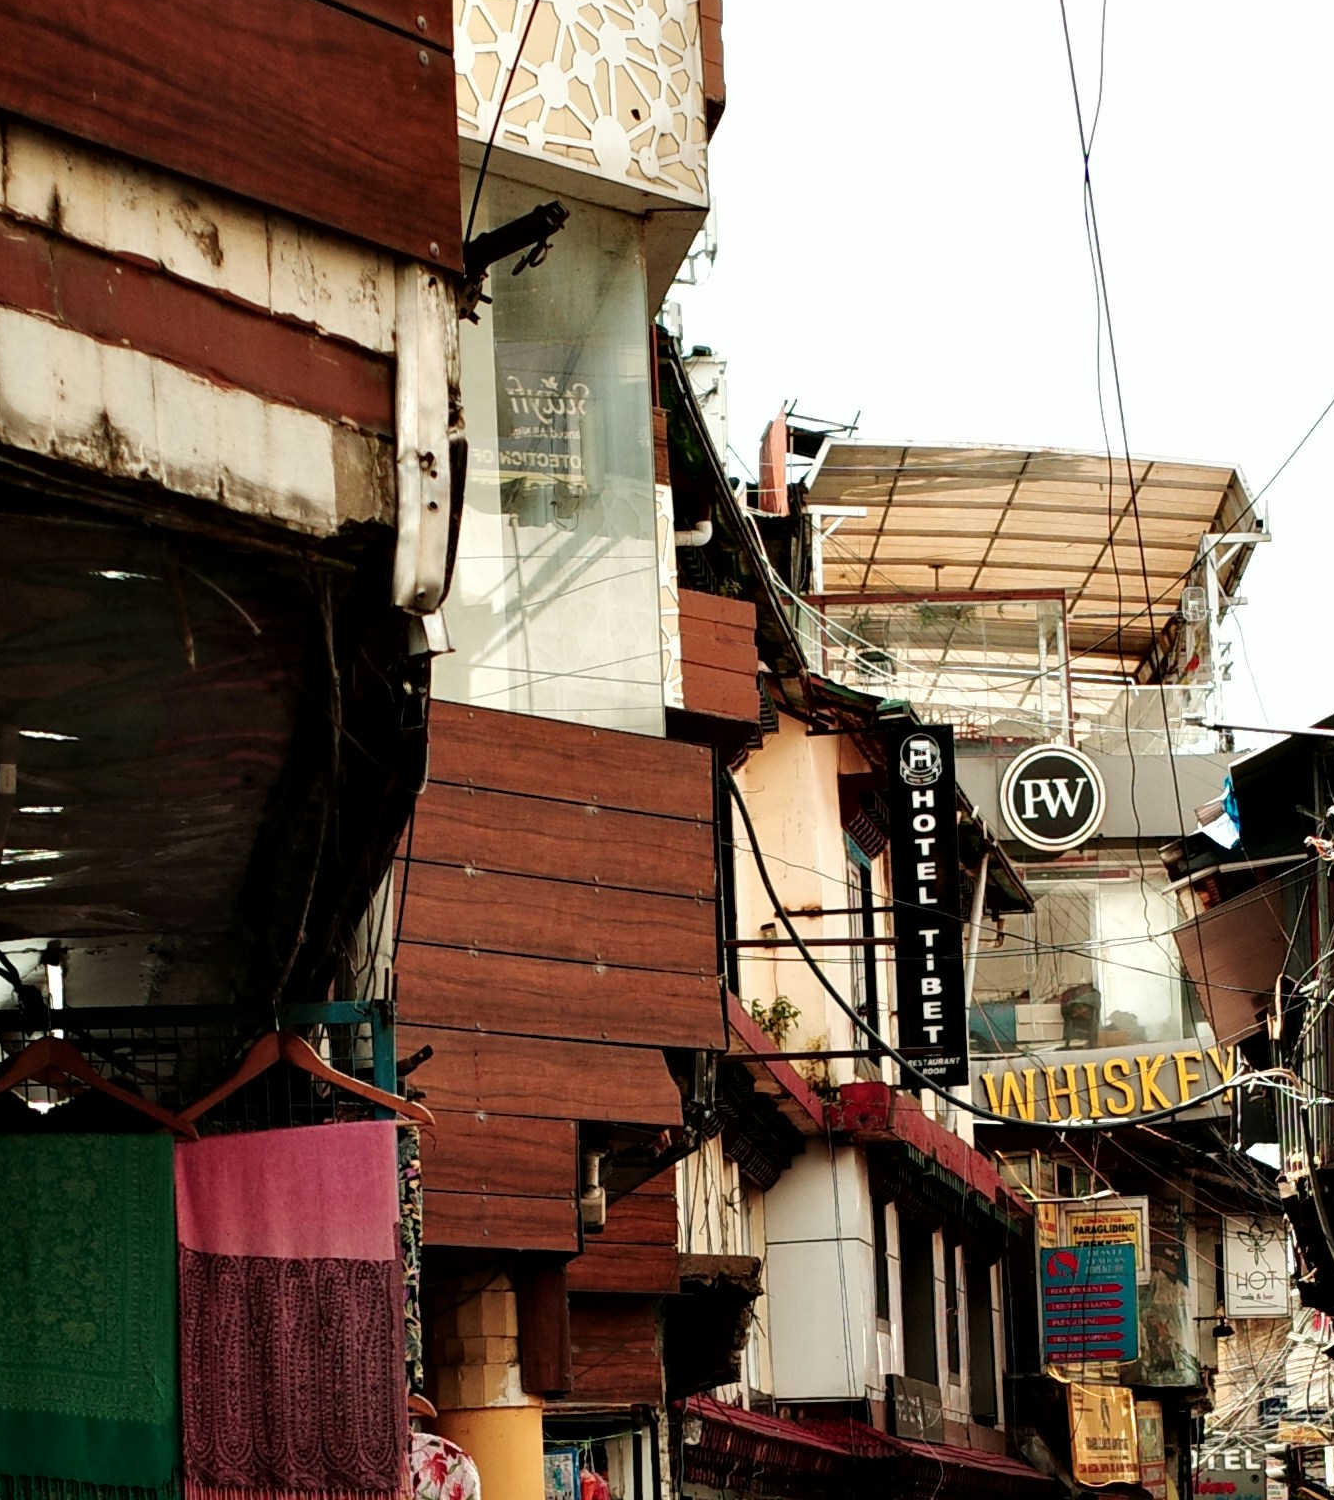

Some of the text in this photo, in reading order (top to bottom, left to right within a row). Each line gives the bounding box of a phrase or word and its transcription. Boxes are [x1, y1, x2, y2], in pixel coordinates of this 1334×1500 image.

[1019, 778, 1088, 819] PW
[912, 790, 938, 904] HOTEL
[907, 1057, 961, 1067] RESTAURANT
[981, 1045, 1234, 1122] WHISKEY
[1073, 1223, 1135, 1236] PARAGLIDING
[1236, 1271, 1277, 1290] HOT
